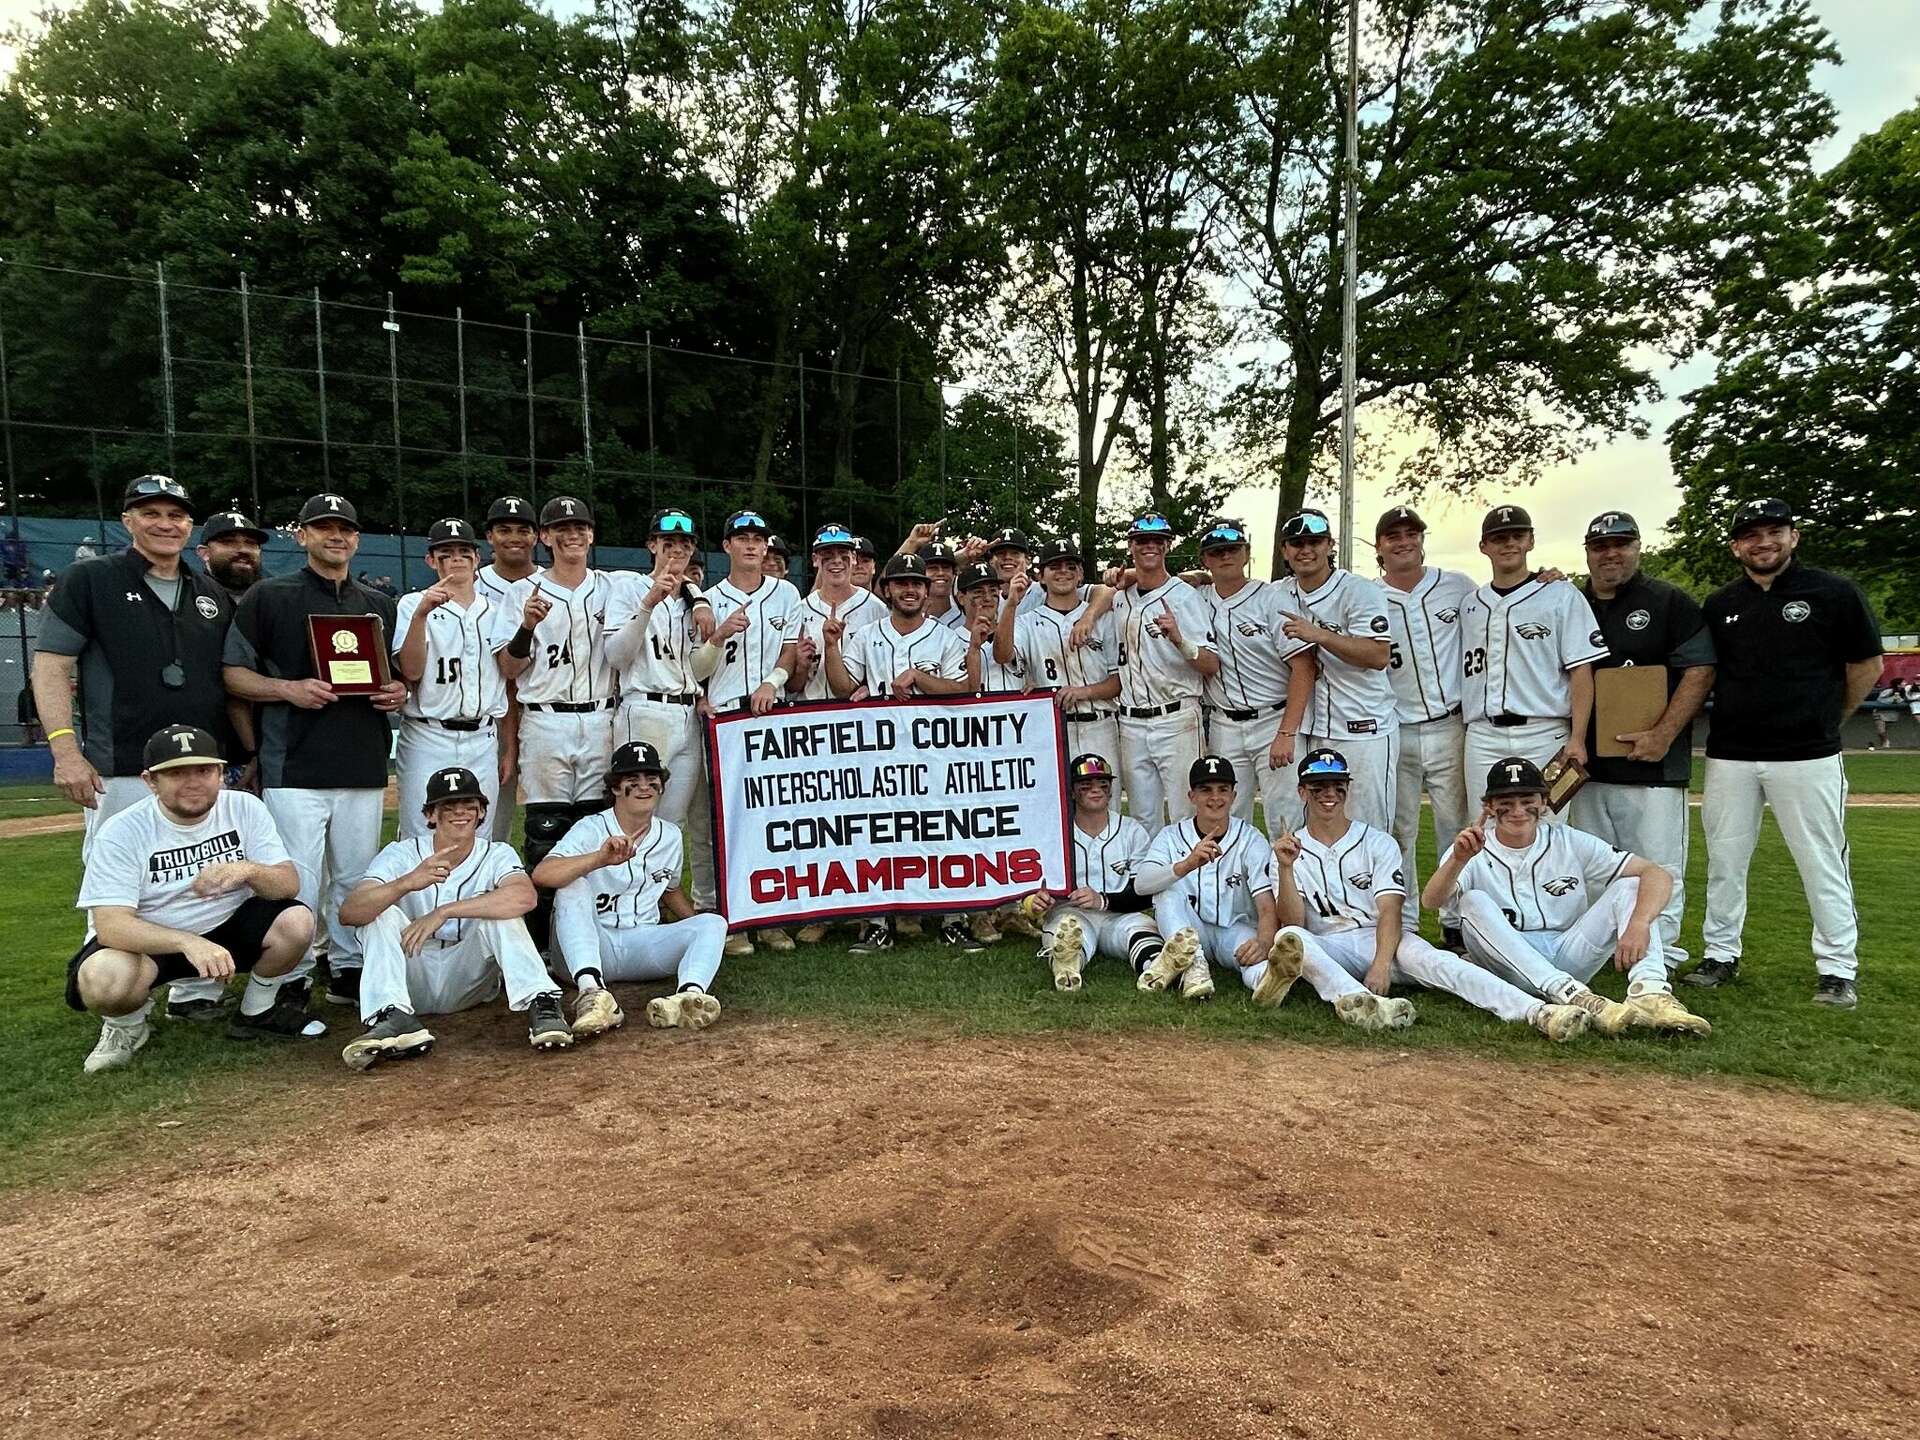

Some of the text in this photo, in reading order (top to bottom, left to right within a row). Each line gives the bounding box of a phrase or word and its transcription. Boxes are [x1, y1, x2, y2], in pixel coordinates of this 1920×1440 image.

[324, 495, 343, 511] T
[505, 499, 520, 513] T
[560, 499, 576, 515] T
[227, 513, 245, 528] T
[1497, 507, 1513, 523] T
[445, 520, 462, 536] T
[1002, 528, 1014, 541] T
[852, 537, 863, 549] T
[932, 543, 944, 556] T
[1055, 539, 1068, 552] T
[902, 554, 915, 568] T
[975, 563, 988, 576] T
[546, 638, 572, 670] 24
[725, 640, 738, 666] 2
[1044, 658, 1058, 681] 8
[1464, 647, 1485, 678] 23
[171, 732, 195, 752] T
[743, 712, 1028, 763] FAIRFIELD COUNTY
[633, 746, 648, 762] T
[1205, 758, 1220, 774] T
[1505, 765, 1523, 783] T
[443, 773, 461, 791] T
[743, 757, 1036, 809] INTERSCHOLASTIC ATHLETIC
[765, 804, 1021, 853] CONFERENCE
[153, 834, 238, 870] TRUMBULL
[749, 848, 1043, 904] CHAMPIONS
